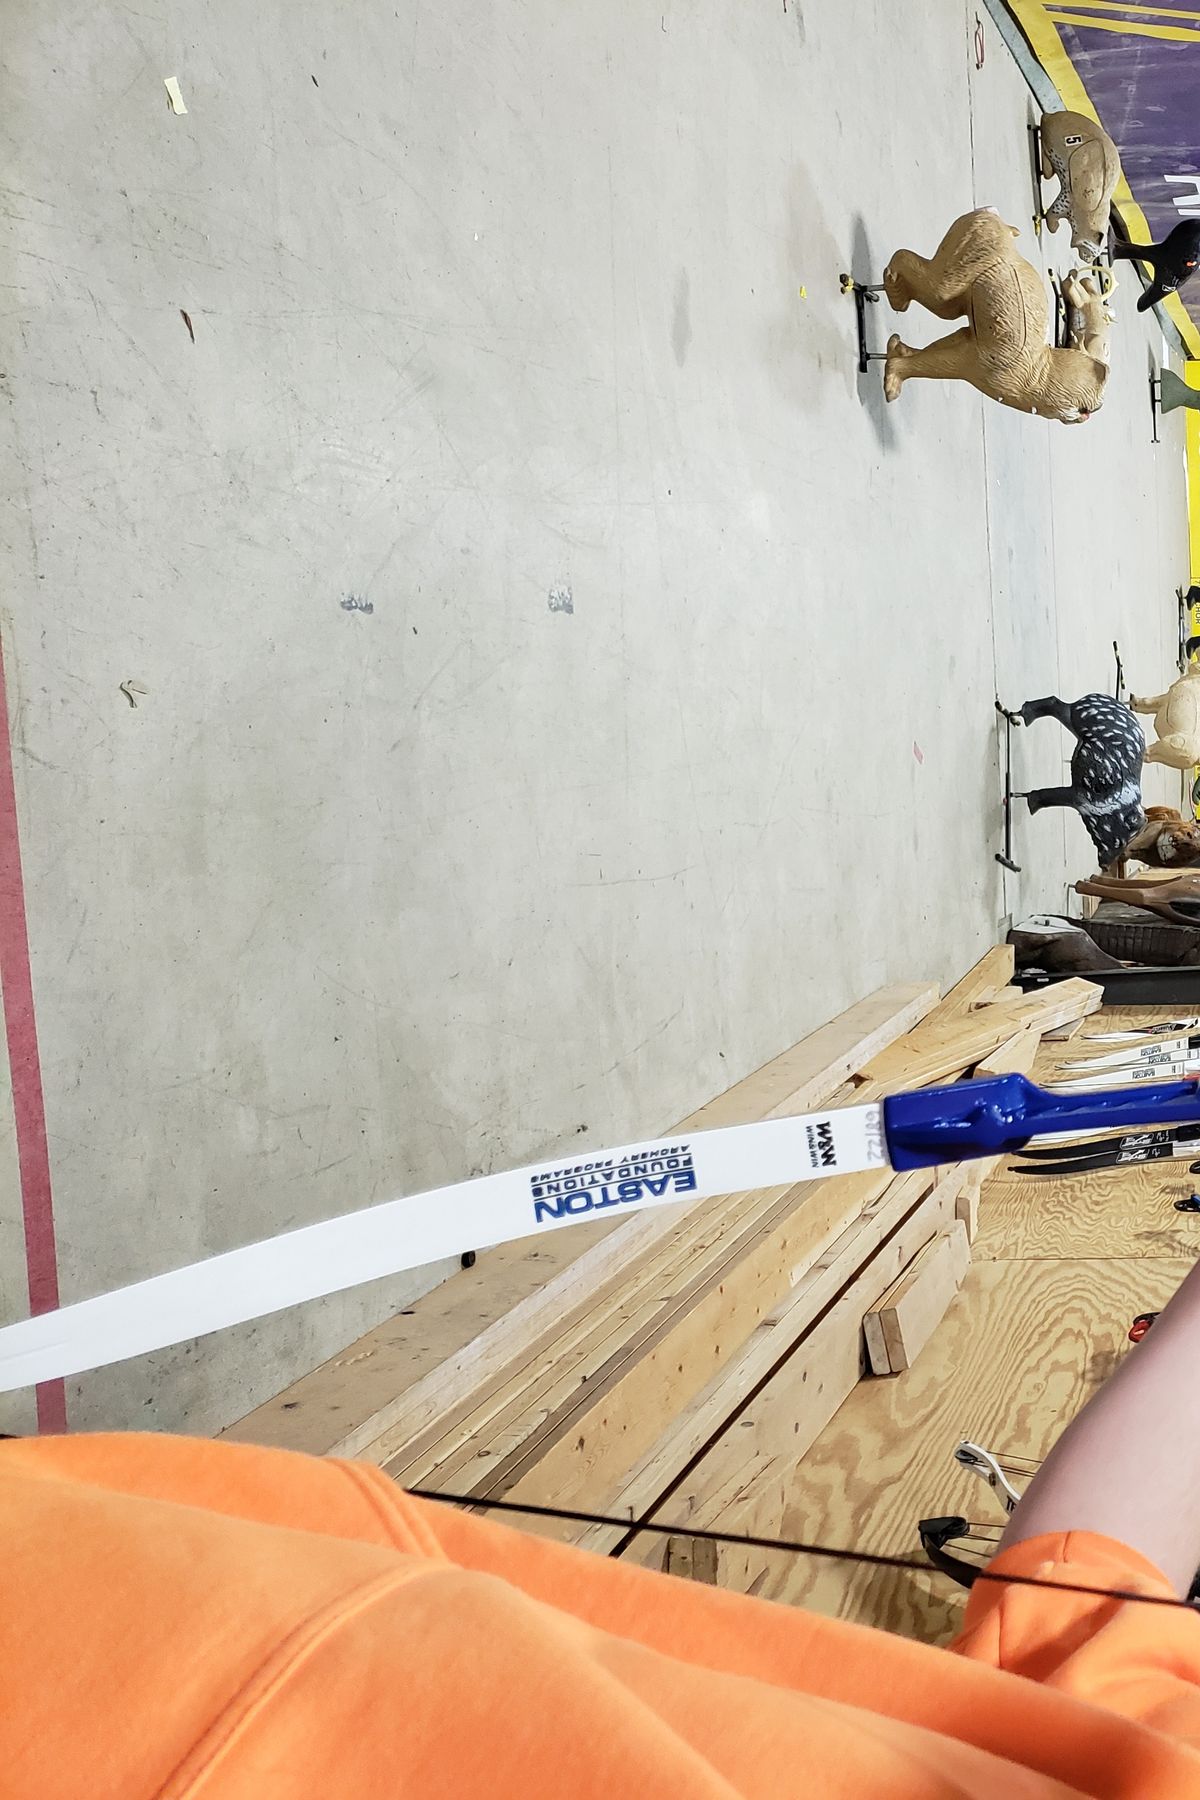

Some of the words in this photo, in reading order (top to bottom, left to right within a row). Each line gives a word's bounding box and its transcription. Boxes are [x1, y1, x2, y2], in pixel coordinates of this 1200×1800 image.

[620, 1144, 690, 1163] ARCHERY
[806, 1126, 819, 1168] WIN&WIN
[816, 1121, 837, 1167] W&W
[531, 1160, 613, 1183] PROGRAMS
[532, 1156, 692, 1197] FOUNDATIONS
[534, 1170, 697, 1223] EASTON
